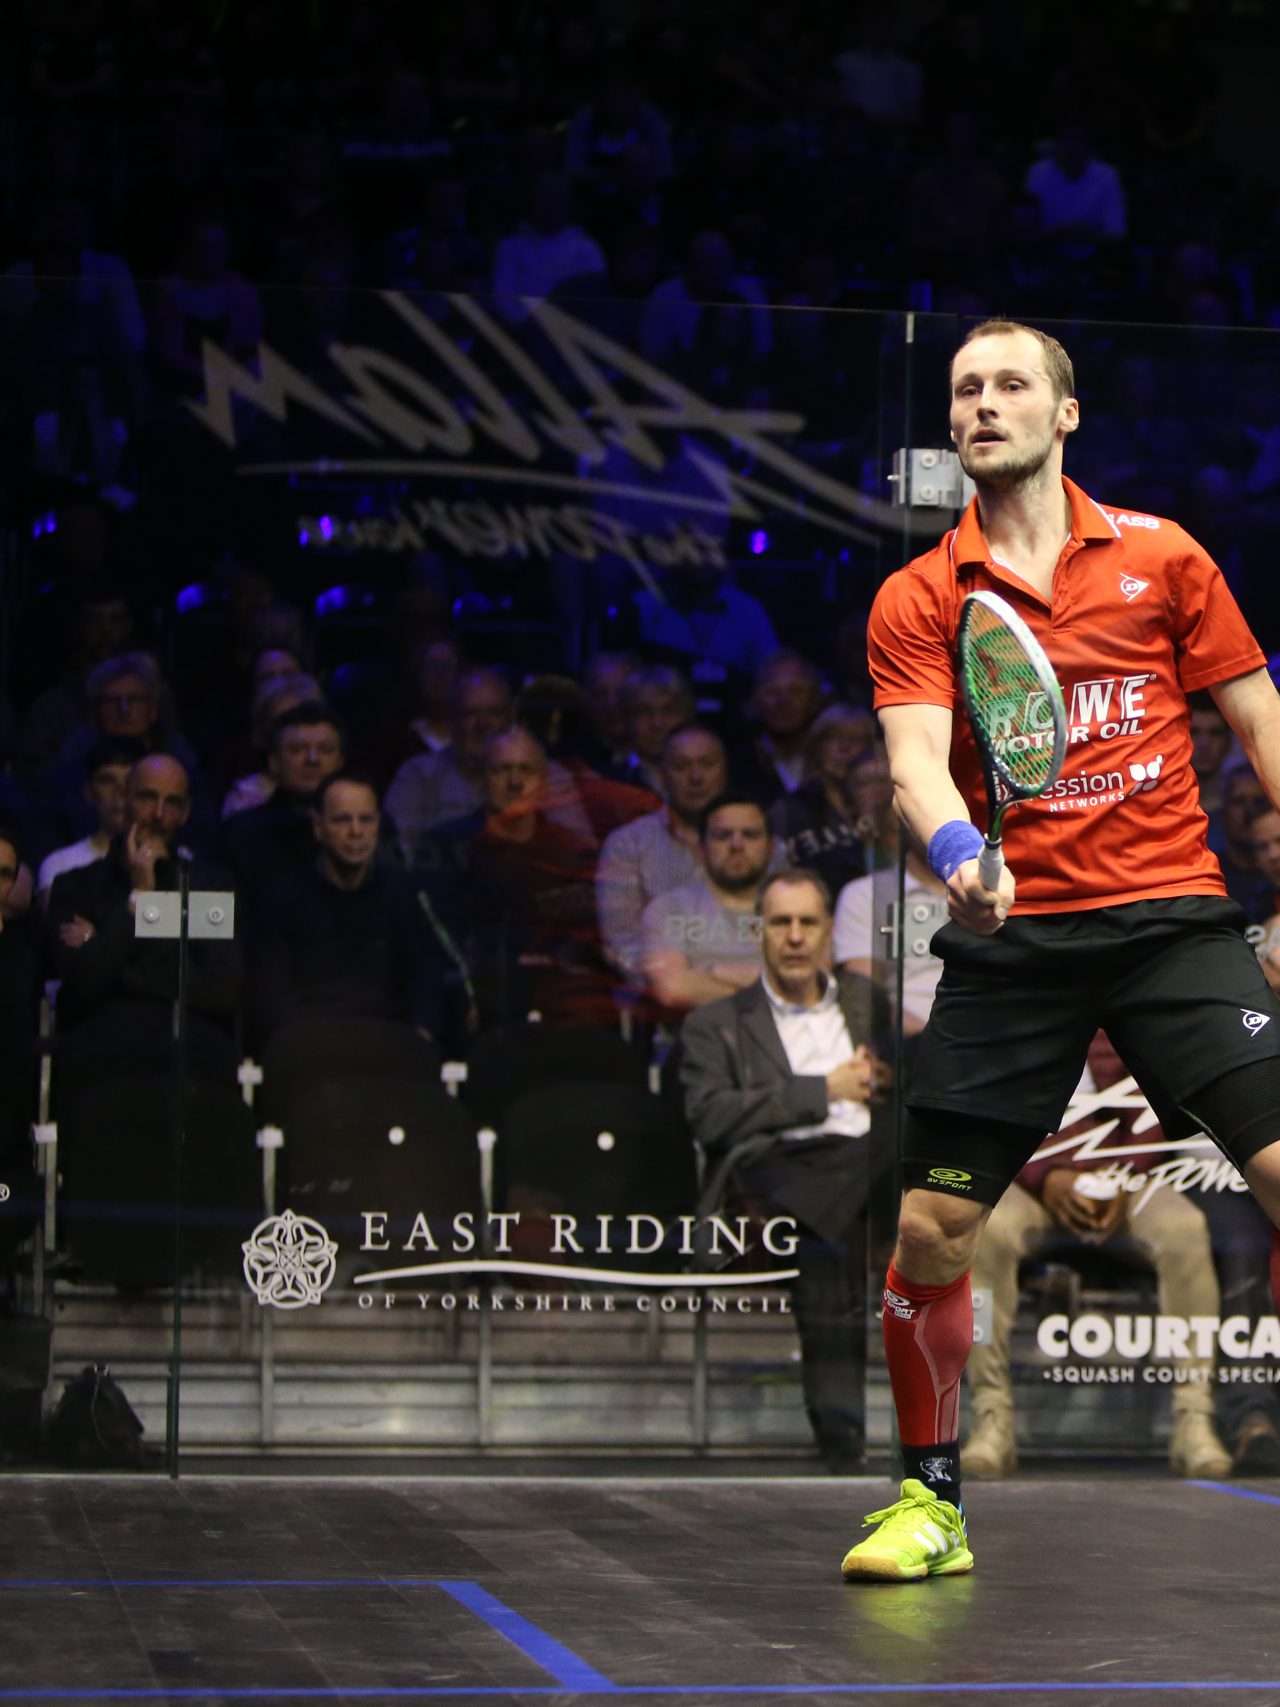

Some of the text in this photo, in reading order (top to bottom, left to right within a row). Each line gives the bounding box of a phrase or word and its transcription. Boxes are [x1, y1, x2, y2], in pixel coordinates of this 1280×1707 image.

[1116, 514, 1160, 529] ASB
[1100, 719, 1143, 739] OIL
[1049, 792, 1125, 812] NETWORKS
[360, 1211, 800, 1256] EAST RIDING
[358, 1293, 793, 1313] OF YORKSHIRE COUNCIL
[1052, 1367, 1135, 1384] SQUASH
[1142, 1367, 1208, 1384] COURT
